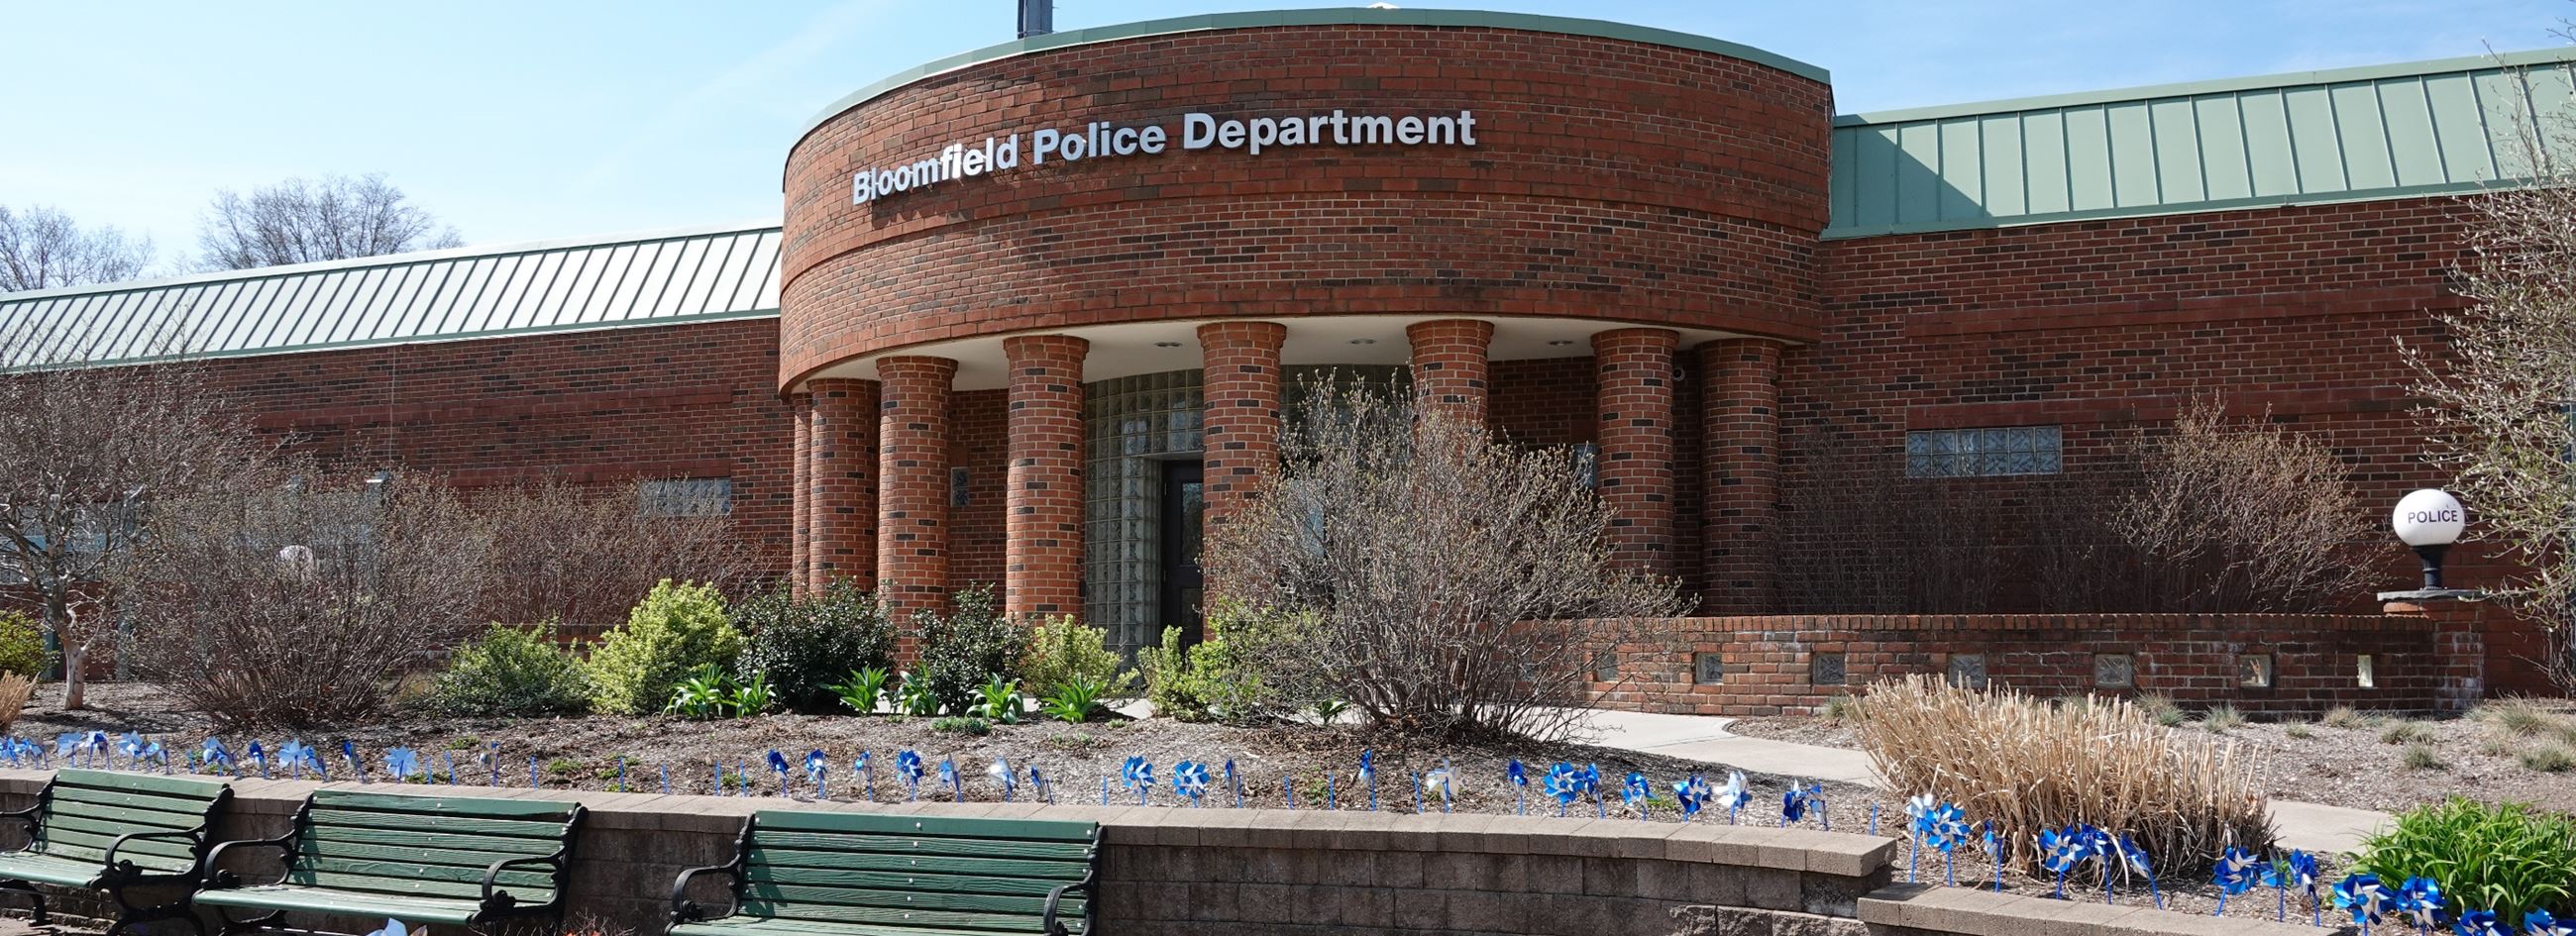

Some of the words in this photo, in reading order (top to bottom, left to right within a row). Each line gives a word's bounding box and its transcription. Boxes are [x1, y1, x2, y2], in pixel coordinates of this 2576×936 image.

[853, 134, 1019, 206] Bloomfield
[1033, 121, 1166, 165] Police
[1183, 109, 1476, 156] Department
[2408, 510, 2458, 524] POLICE
